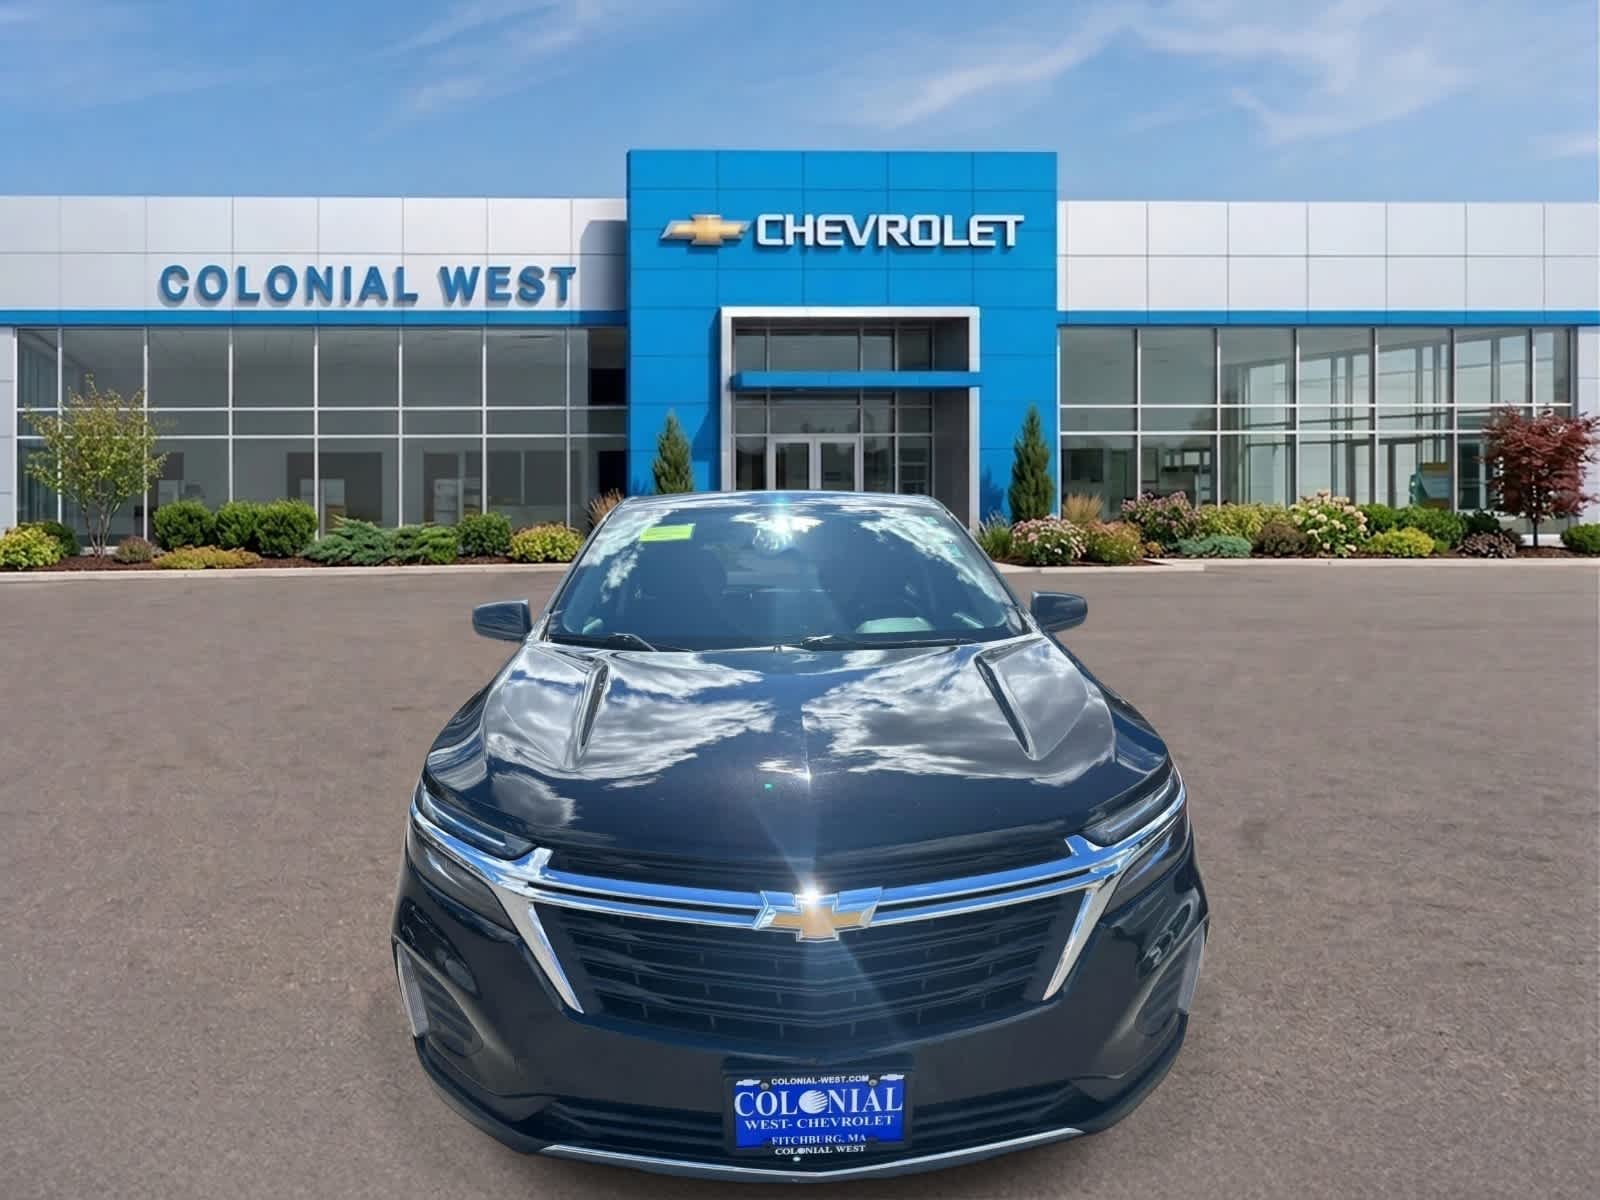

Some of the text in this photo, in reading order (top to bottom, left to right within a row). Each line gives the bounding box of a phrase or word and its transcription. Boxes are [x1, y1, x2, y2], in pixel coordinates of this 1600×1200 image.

[756, 214, 1025, 248] CHEVROLET
[160, 264, 577, 304] COLONIAL WEST
[771, 1075, 870, 1086] COLONIAL-WEST.COM
[734, 1087, 903, 1117] COLONIAL
[797, 1115, 895, 1129] CHEVROLET
[849, 1133, 867, 1143] MA
[775, 1145, 866, 1156] COLONIAL WEST
